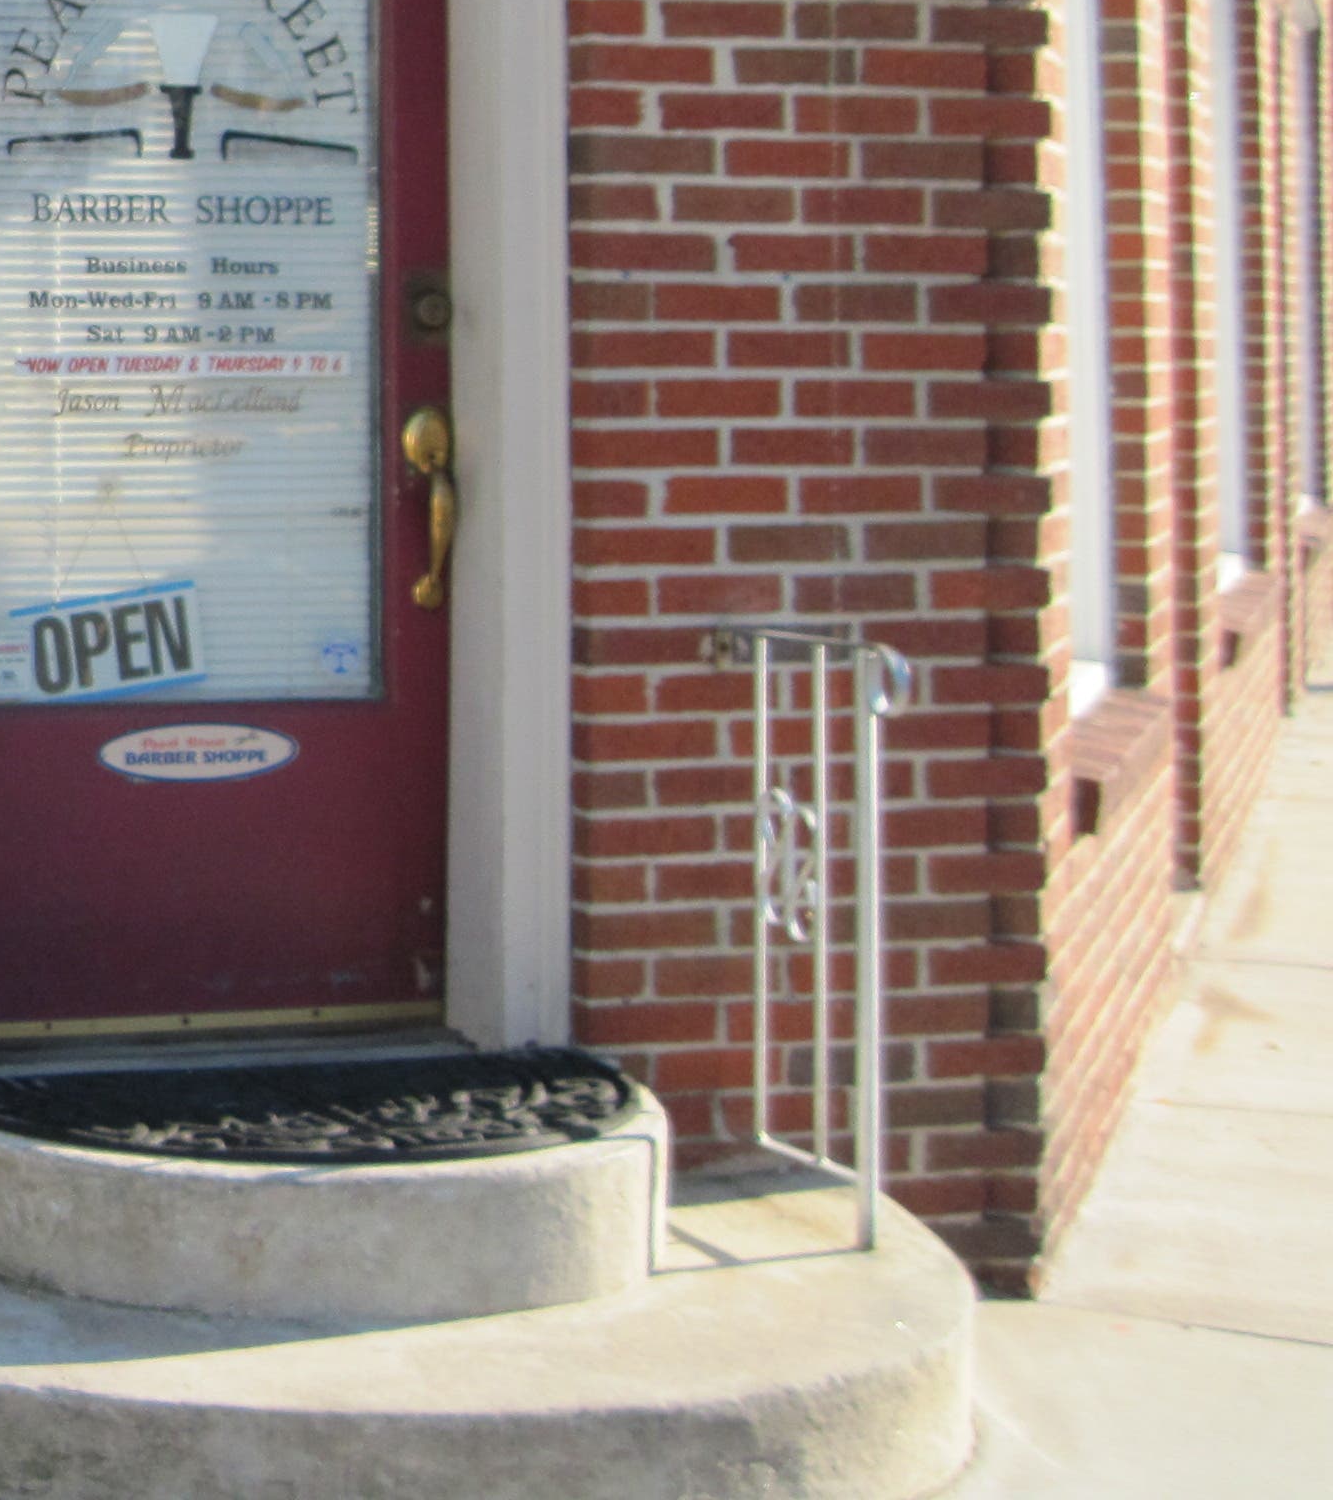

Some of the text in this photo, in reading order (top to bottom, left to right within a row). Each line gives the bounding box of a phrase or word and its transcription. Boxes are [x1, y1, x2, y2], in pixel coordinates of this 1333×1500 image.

[33, 193, 335, 226] BARBER SHOPPE
[84, 257, 280, 275] Business Hours
[28, 290, 177, 309] Mon-Wed-Fri
[198, 292, 213, 309] 9
[218, 292, 255, 309] AM
[276, 292, 290, 309] 8
[295, 292, 333, 309] PM
[86, 325, 125, 343] Sat
[144, 325, 158, 343] 9
[164, 325, 202, 343] AM
[239, 326, 277, 343] PM
[68, 357, 109, 373] OPEN
[117, 357, 183, 373] TUESDAY
[53, 388, 122, 417] Jason
[33, 596, 192, 694] OPEN
[124, 749, 267, 766] BARBER SHOPPE
